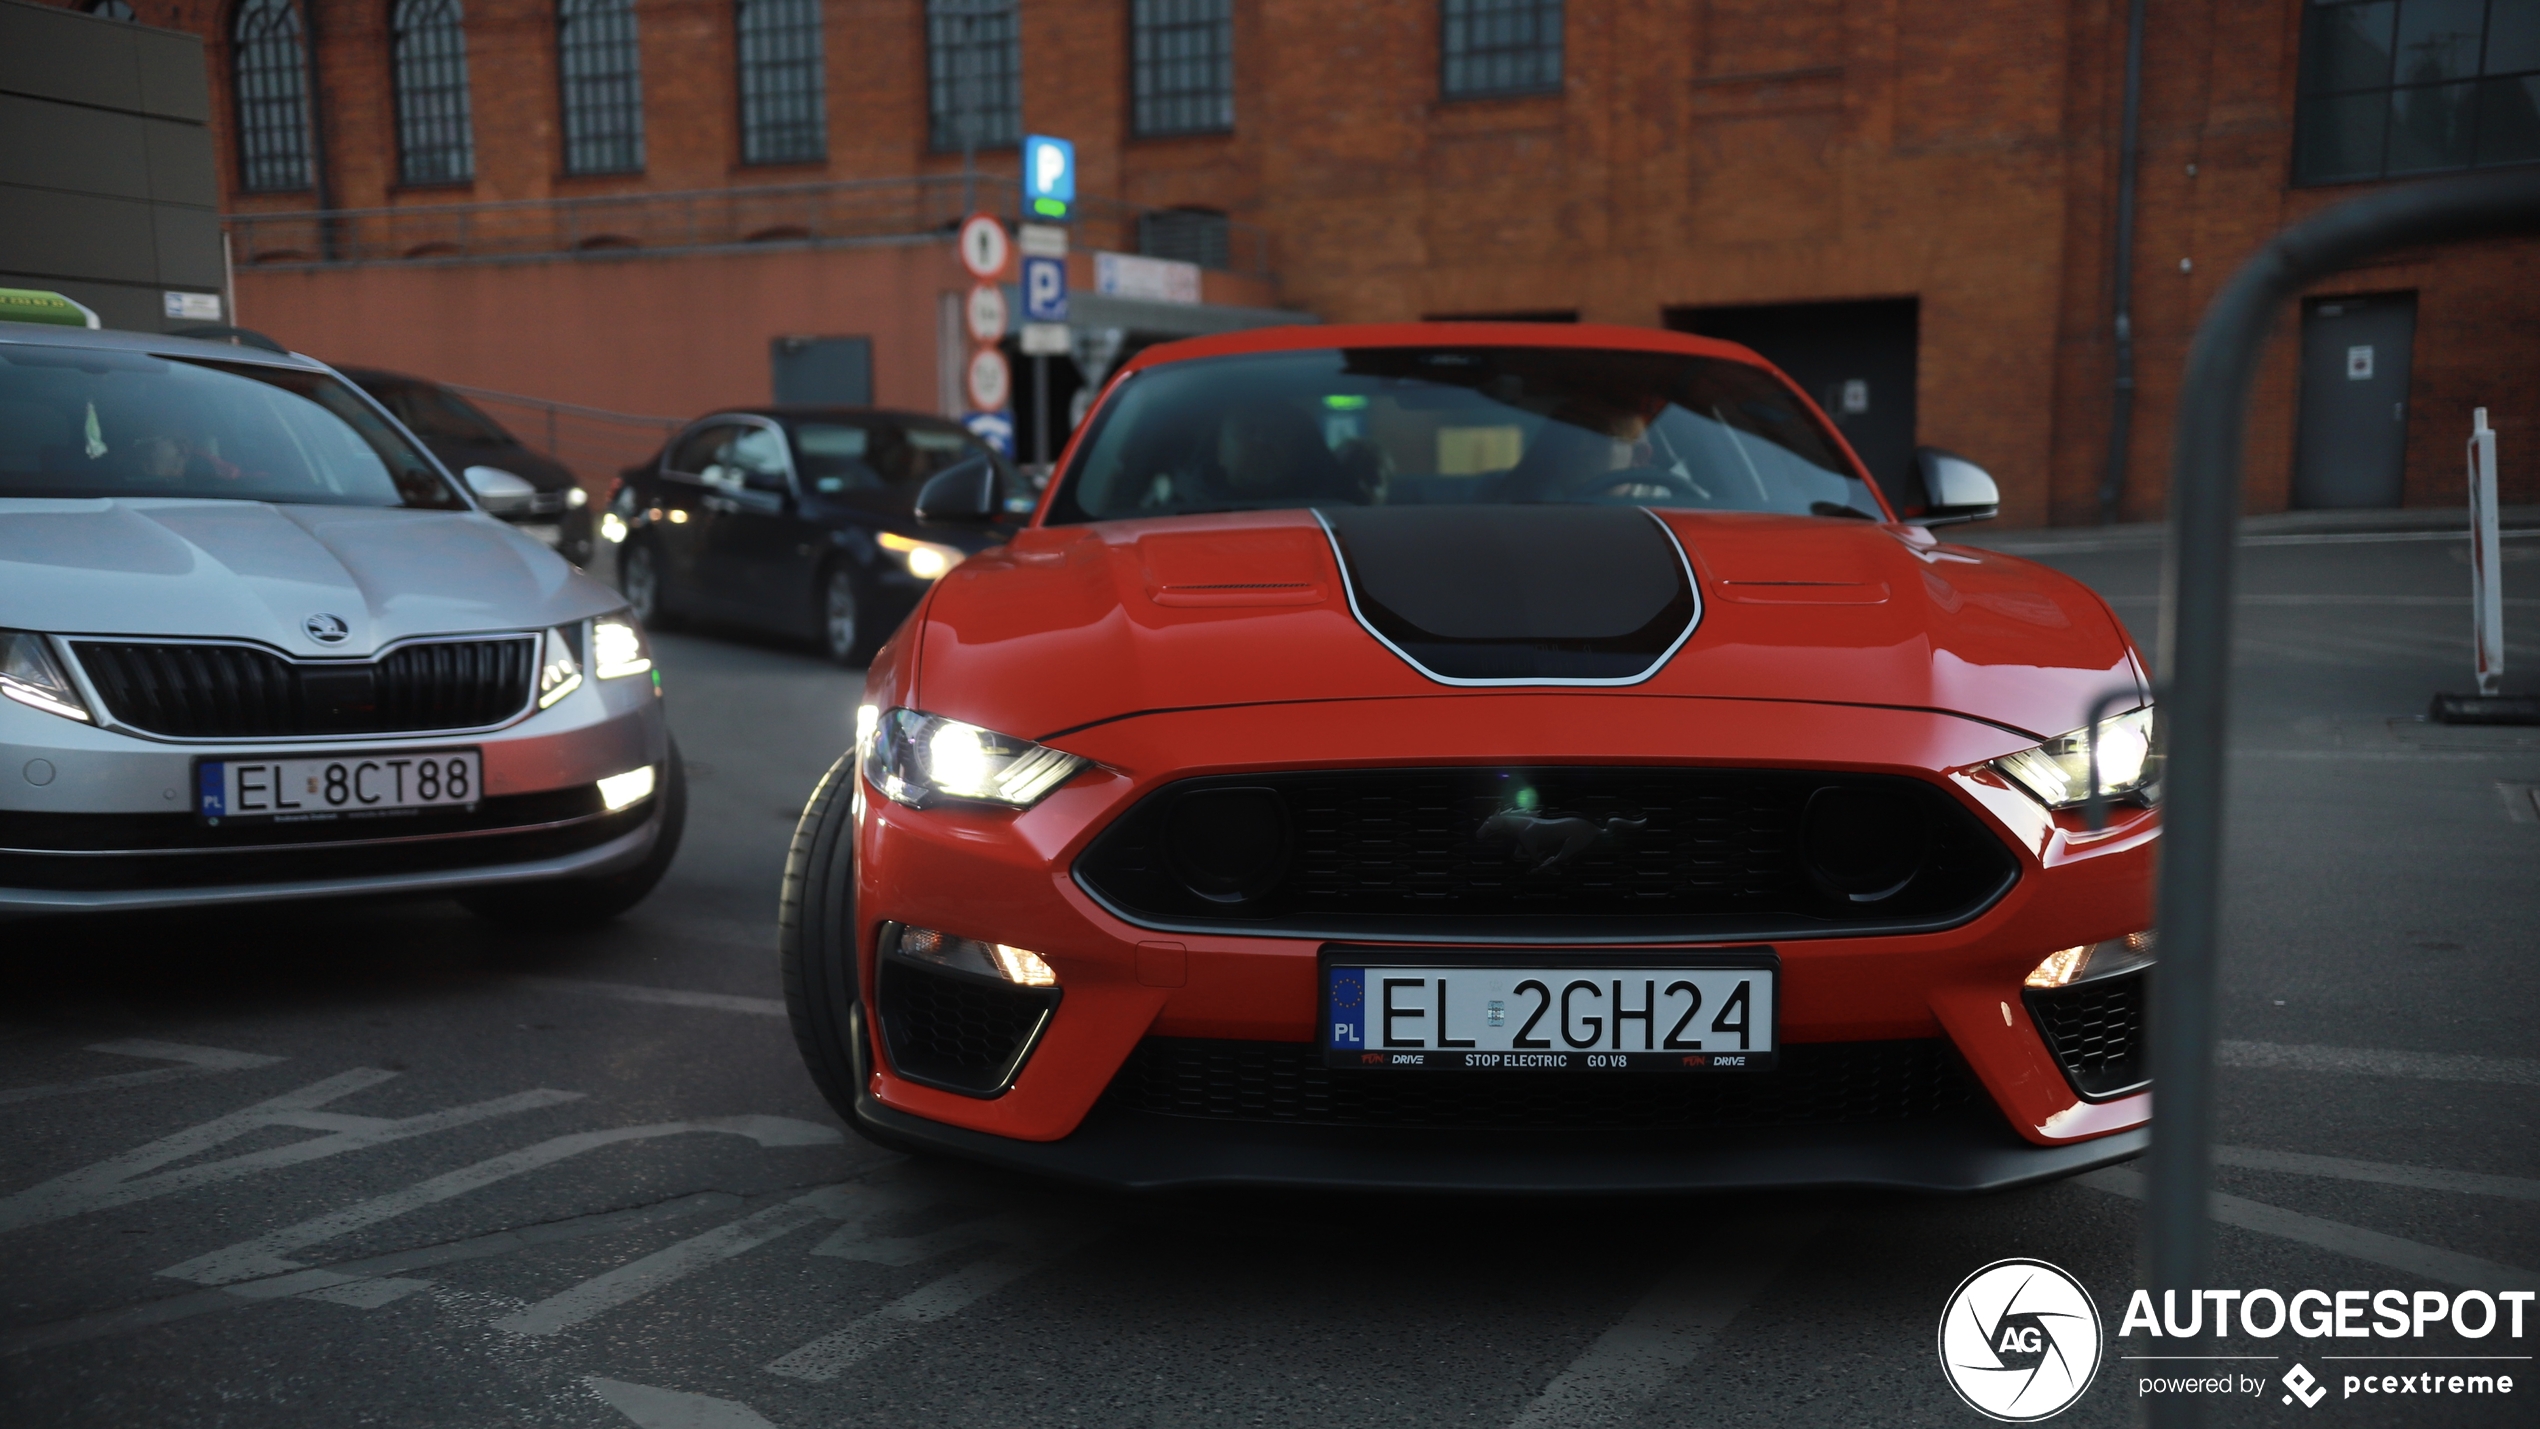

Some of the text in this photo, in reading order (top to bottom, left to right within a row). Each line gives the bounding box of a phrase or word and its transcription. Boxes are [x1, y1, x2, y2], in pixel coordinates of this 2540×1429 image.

[1035, 143, 1066, 194] P
[1029, 262, 1061, 316] P
[237, 757, 470, 811] EL 8CT88
[203, 795, 222, 809] PL
[1382, 978, 1750, 1050] EL 2GH24
[1334, 1023, 1360, 1043] PL
[1391, 1054, 1425, 1065] DRIVE
[1465, 1054, 1568, 1068] STOP ELECTRIC
[1587, 1054, 1628, 1068] GO V8
[1713, 1056, 1746, 1066] DRIVE
